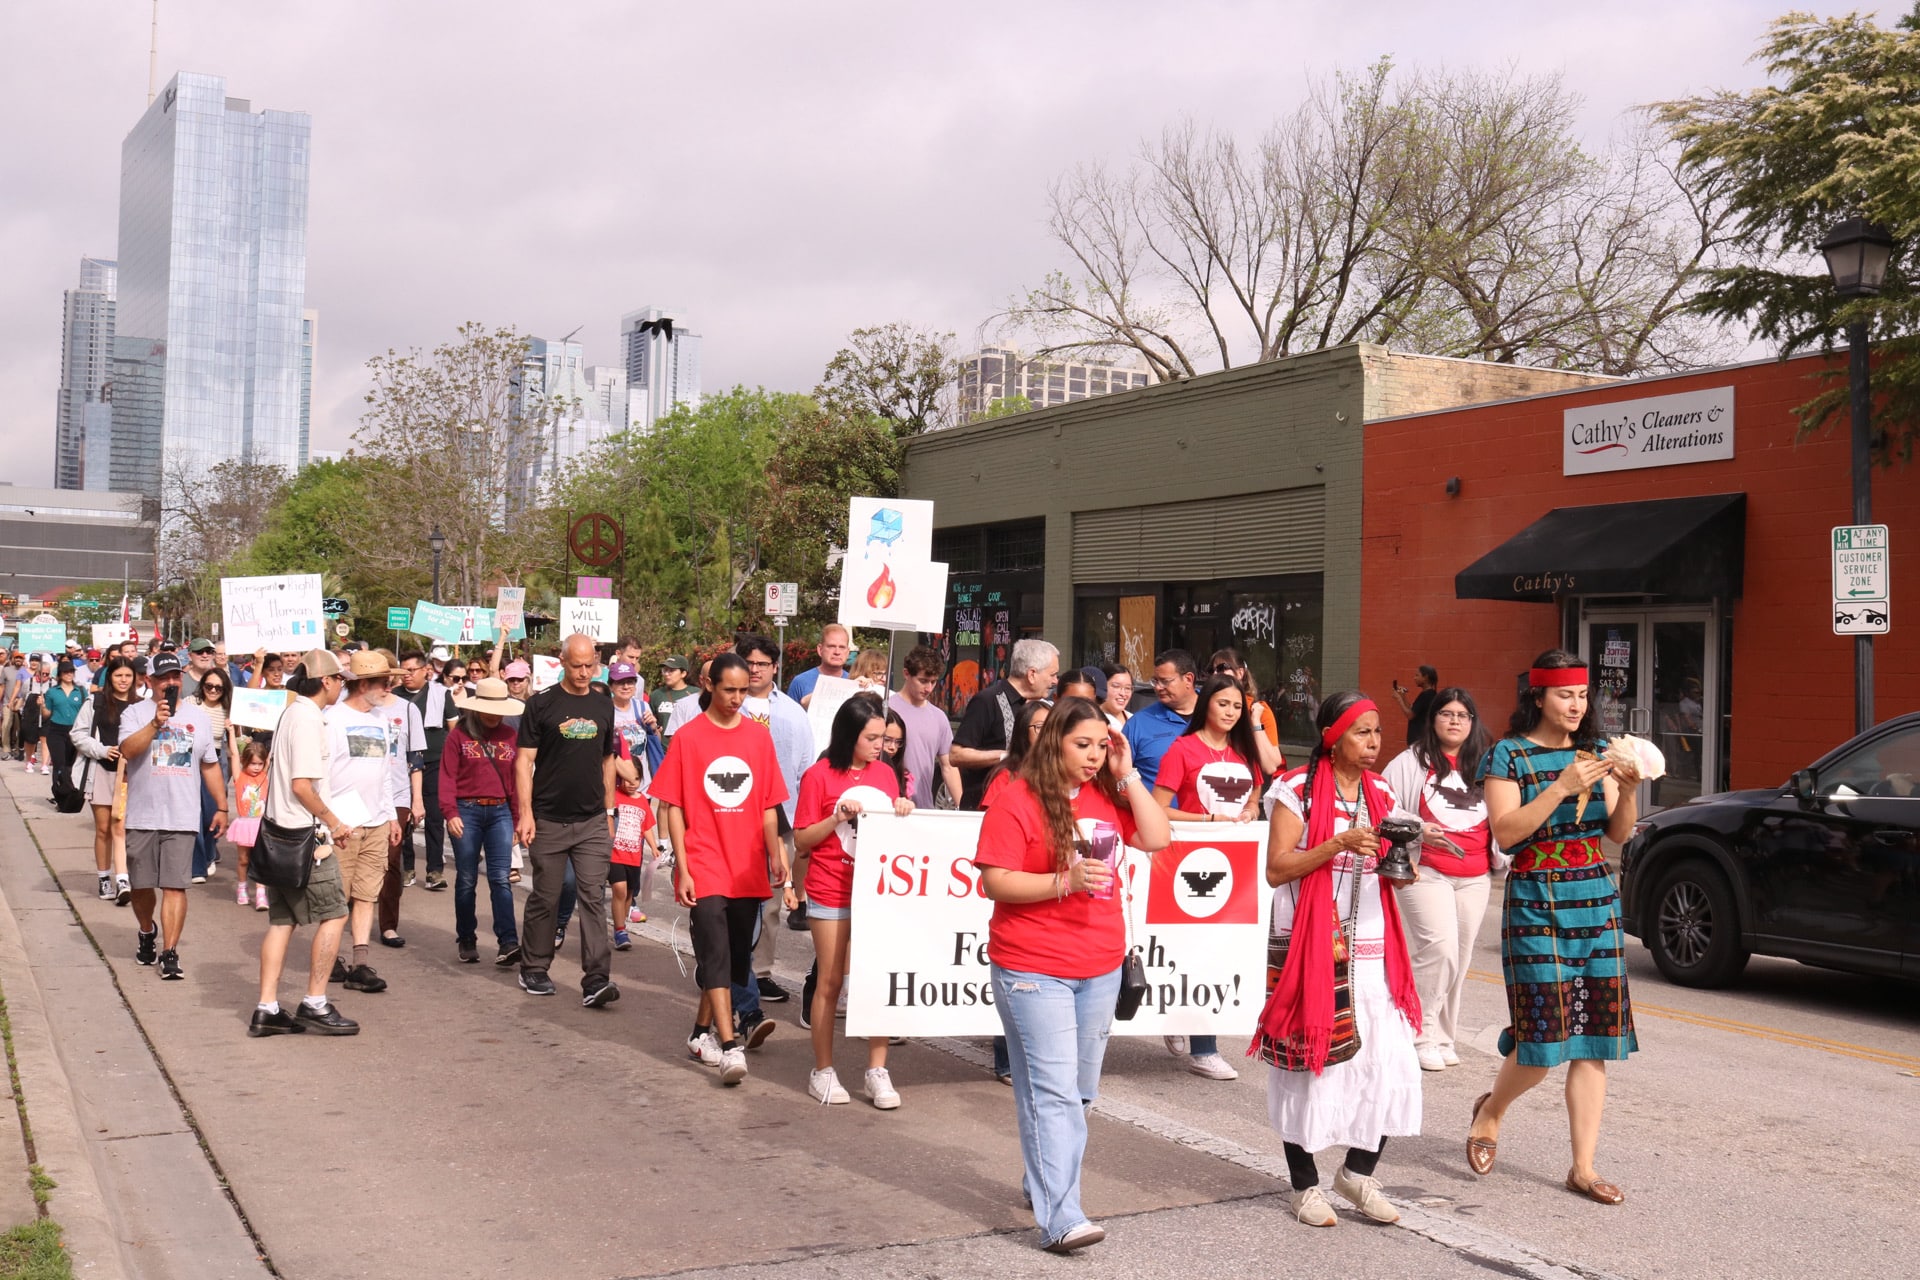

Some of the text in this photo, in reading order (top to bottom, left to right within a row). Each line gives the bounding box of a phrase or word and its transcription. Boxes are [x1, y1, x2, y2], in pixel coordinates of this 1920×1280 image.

[1572, 405, 1724, 447] Cathy's Cleaners &
[1641, 430, 1724, 452] Alterations
[1836, 529, 1849, 542] 15
[1853, 529, 1883, 538] AT ANY
[1859, 538, 1877, 547] TIME
[1839, 552, 1882, 563] CUSTOMER
[1844, 564, 1878, 575] SERVICE
[1513, 572, 1576, 594] Cathy's
[1850, 576, 1871, 586] ZONE
[270, 599, 313, 618] Human
[420, 605, 444, 618] Health
[445, 611, 462, 622] Care
[428, 615, 438, 623] for
[571, 610, 603, 620] WILL
[995, 610, 1009, 622] OPEN
[573, 625, 600, 636] WIN
